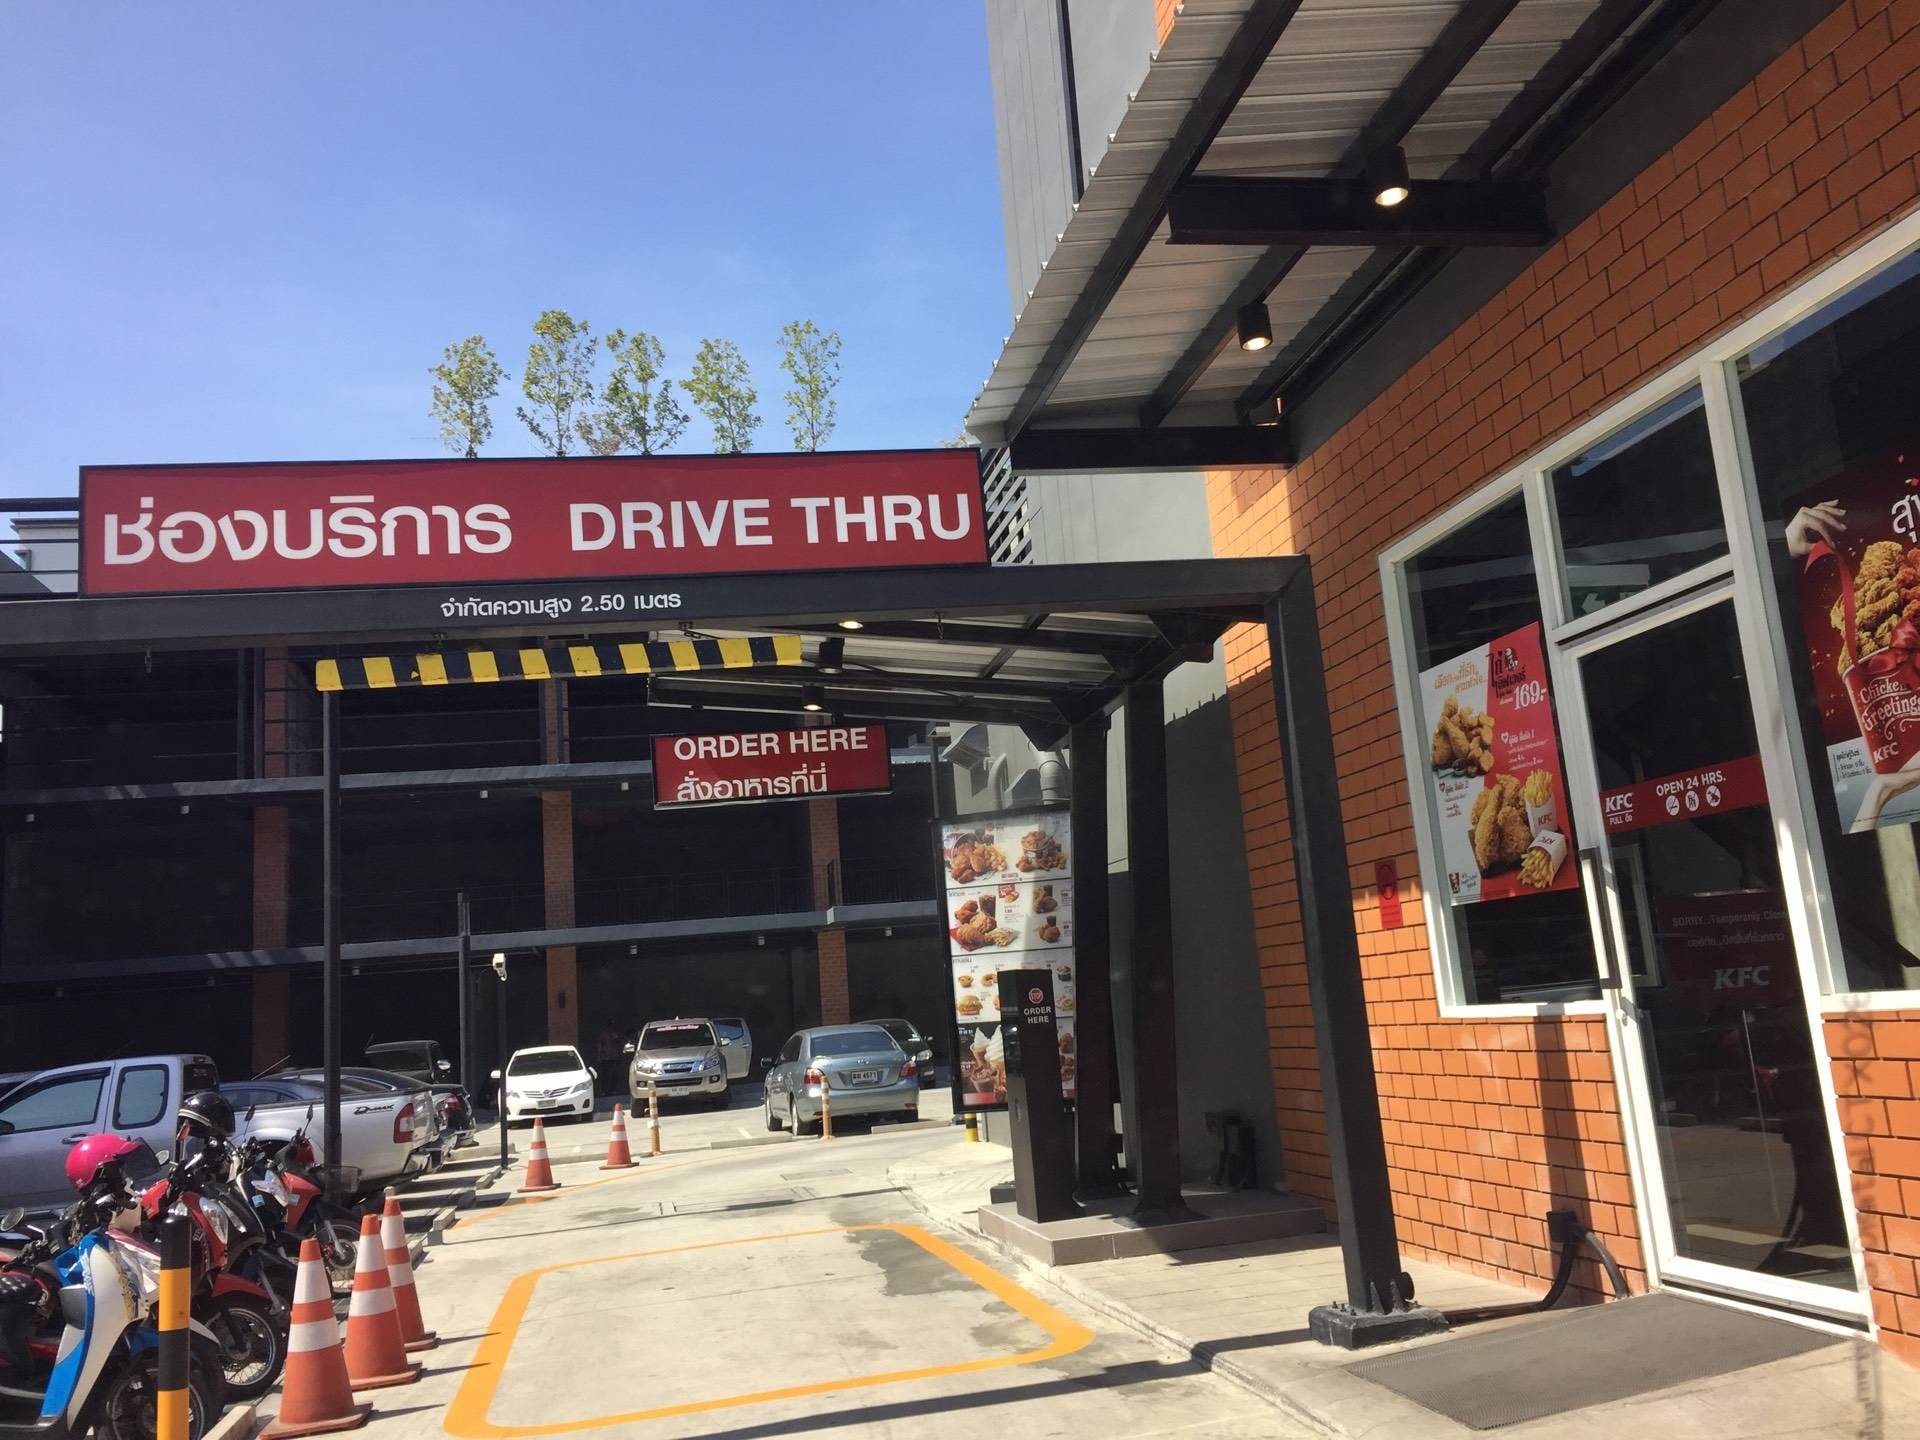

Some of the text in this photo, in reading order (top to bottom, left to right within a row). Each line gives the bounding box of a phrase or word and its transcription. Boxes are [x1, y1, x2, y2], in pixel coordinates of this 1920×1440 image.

[103, 495, 513, 565] ช่องบริการ
[569, 493, 971, 552] DRIVE THRU
[440, 593, 682, 618] จำกัดความสูง 2.50 เมตร
[674, 727, 868, 761] ORDER HERE
[1873, 742, 1899, 764] KFC
[677, 762, 828, 801] สั่งอาหารที่นี่
[1656, 770, 1726, 796] OPEN 24 HRS.
[1605, 793, 1633, 812] KFC
[1609, 815, 1623, 825] PULL
[1713, 966, 1770, 990] KFC
[1023, 1006, 1051, 1016] ORDER
[1027, 1015, 1049, 1024] HERE
